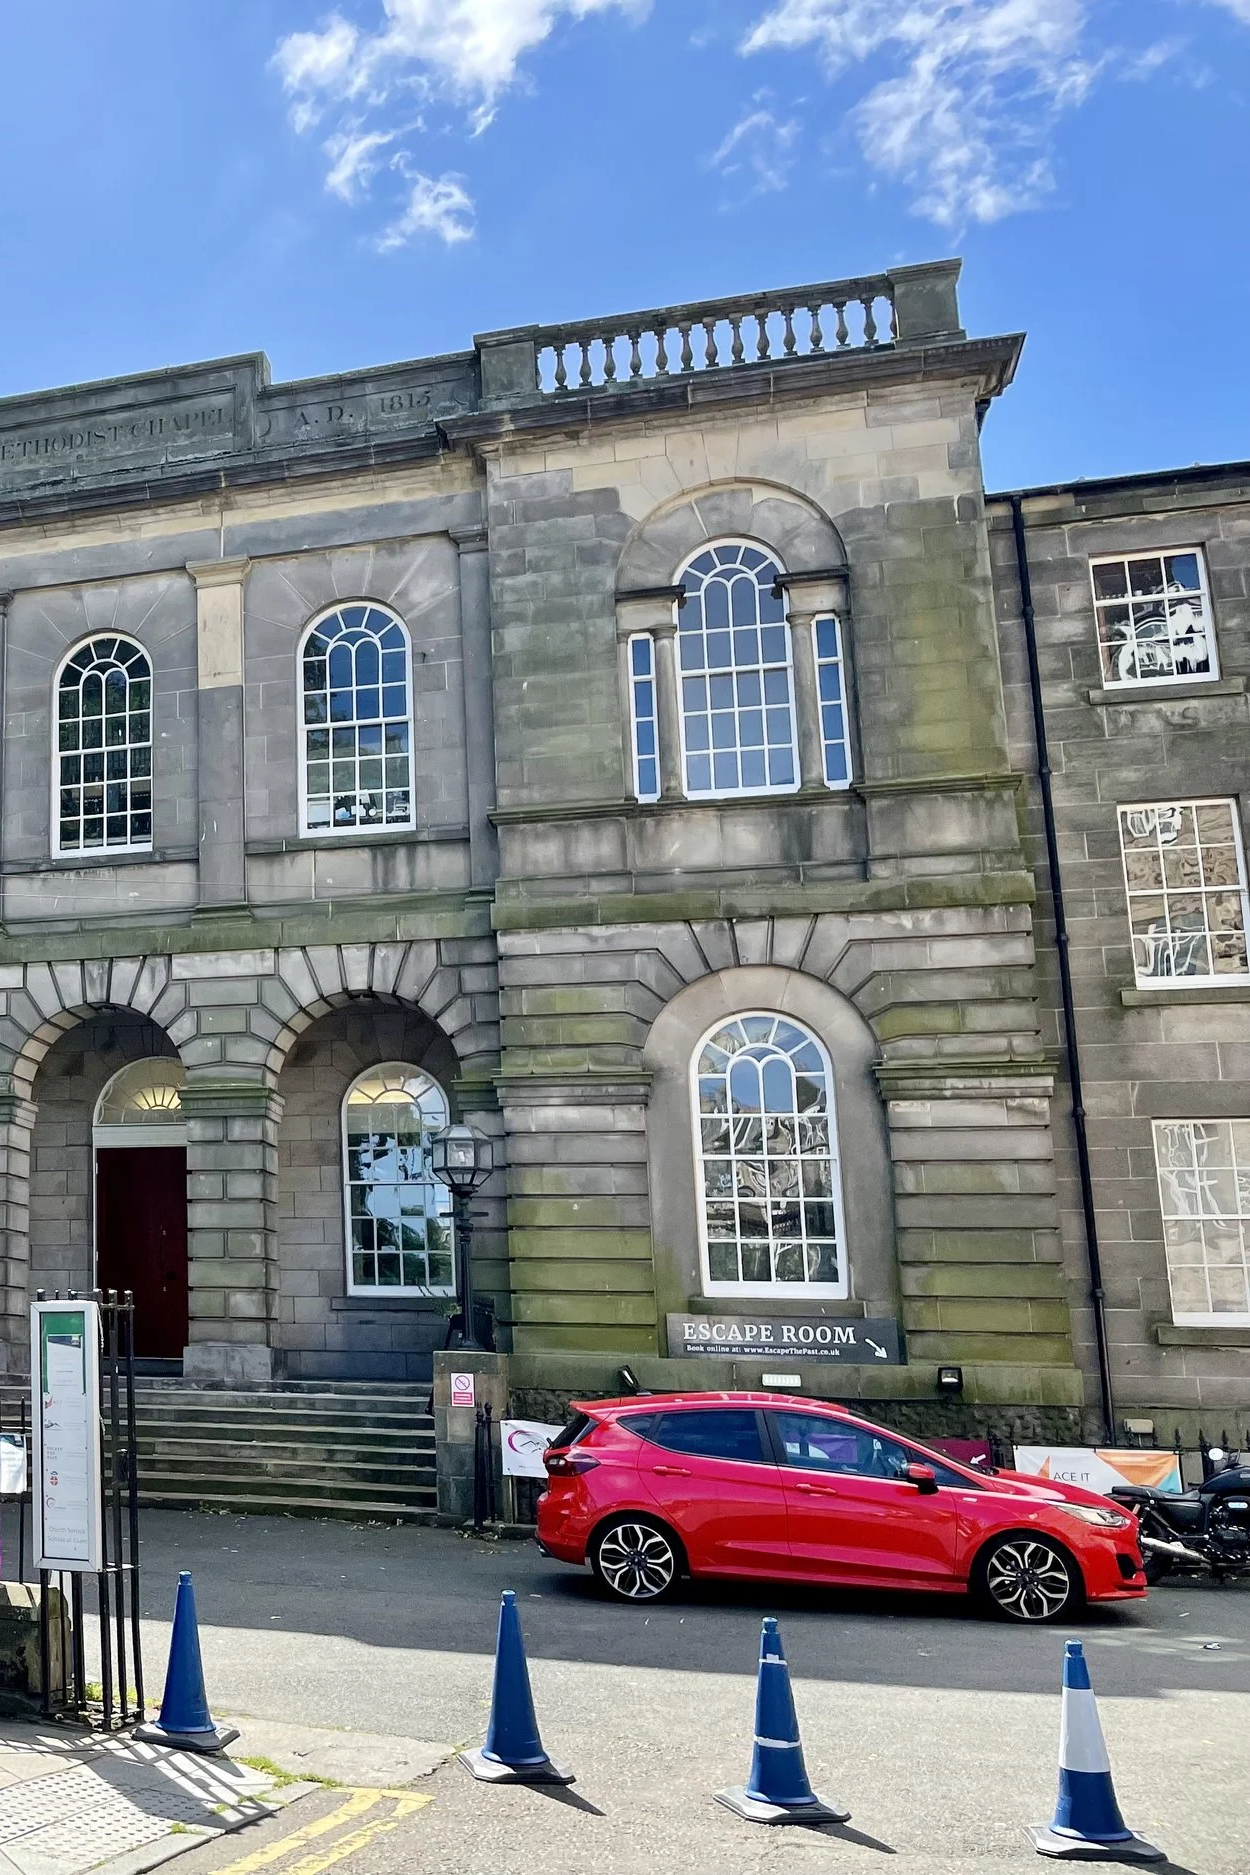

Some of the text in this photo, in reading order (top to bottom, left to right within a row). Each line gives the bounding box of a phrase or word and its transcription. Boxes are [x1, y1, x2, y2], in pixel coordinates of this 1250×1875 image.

[379, 390, 432, 412] 1815
[131, 408, 231, 437] CHAPEL
[682, 1322, 856, 1344] ESCAPE ROOM
[744, 1346, 840, 1356] www.EscapeThePast.co.uk
[1054, 1472, 1090, 1482] ACE IT
